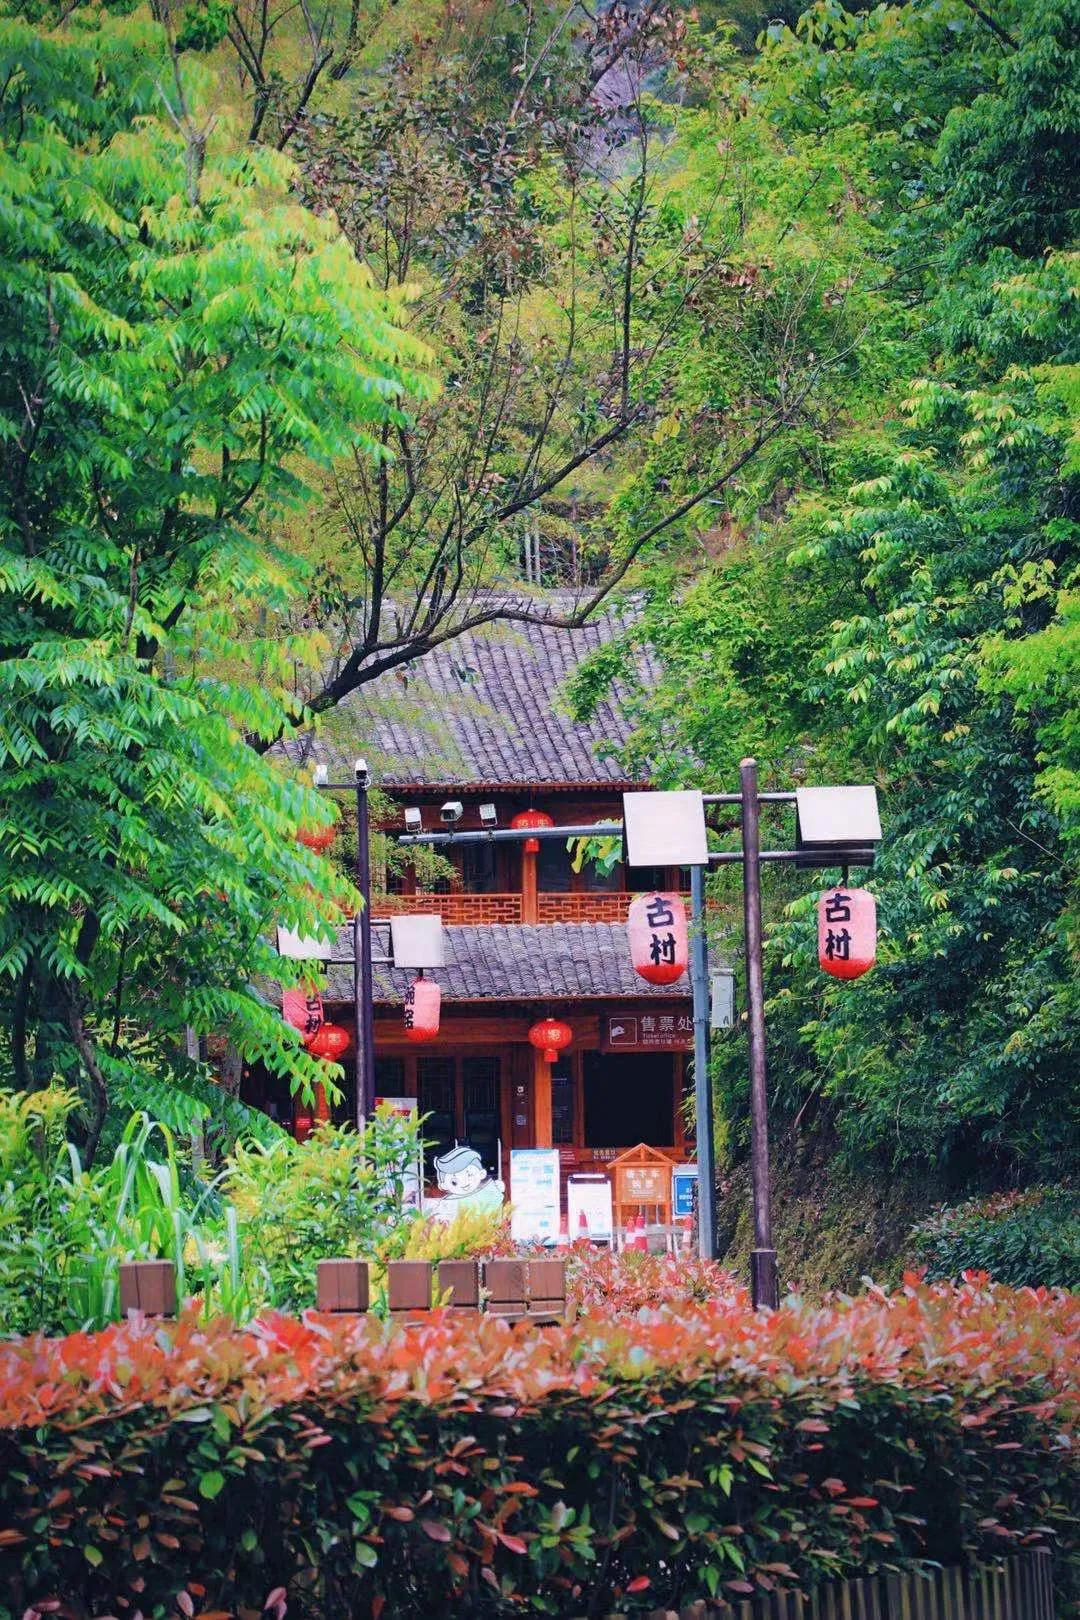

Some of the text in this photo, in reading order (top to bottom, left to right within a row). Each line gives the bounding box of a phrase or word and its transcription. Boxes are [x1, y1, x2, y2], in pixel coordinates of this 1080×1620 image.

[646, 896, 677, 966] 古村
[825, 892, 852, 961] 古村
[640, 1016, 693, 1032] 售票处
